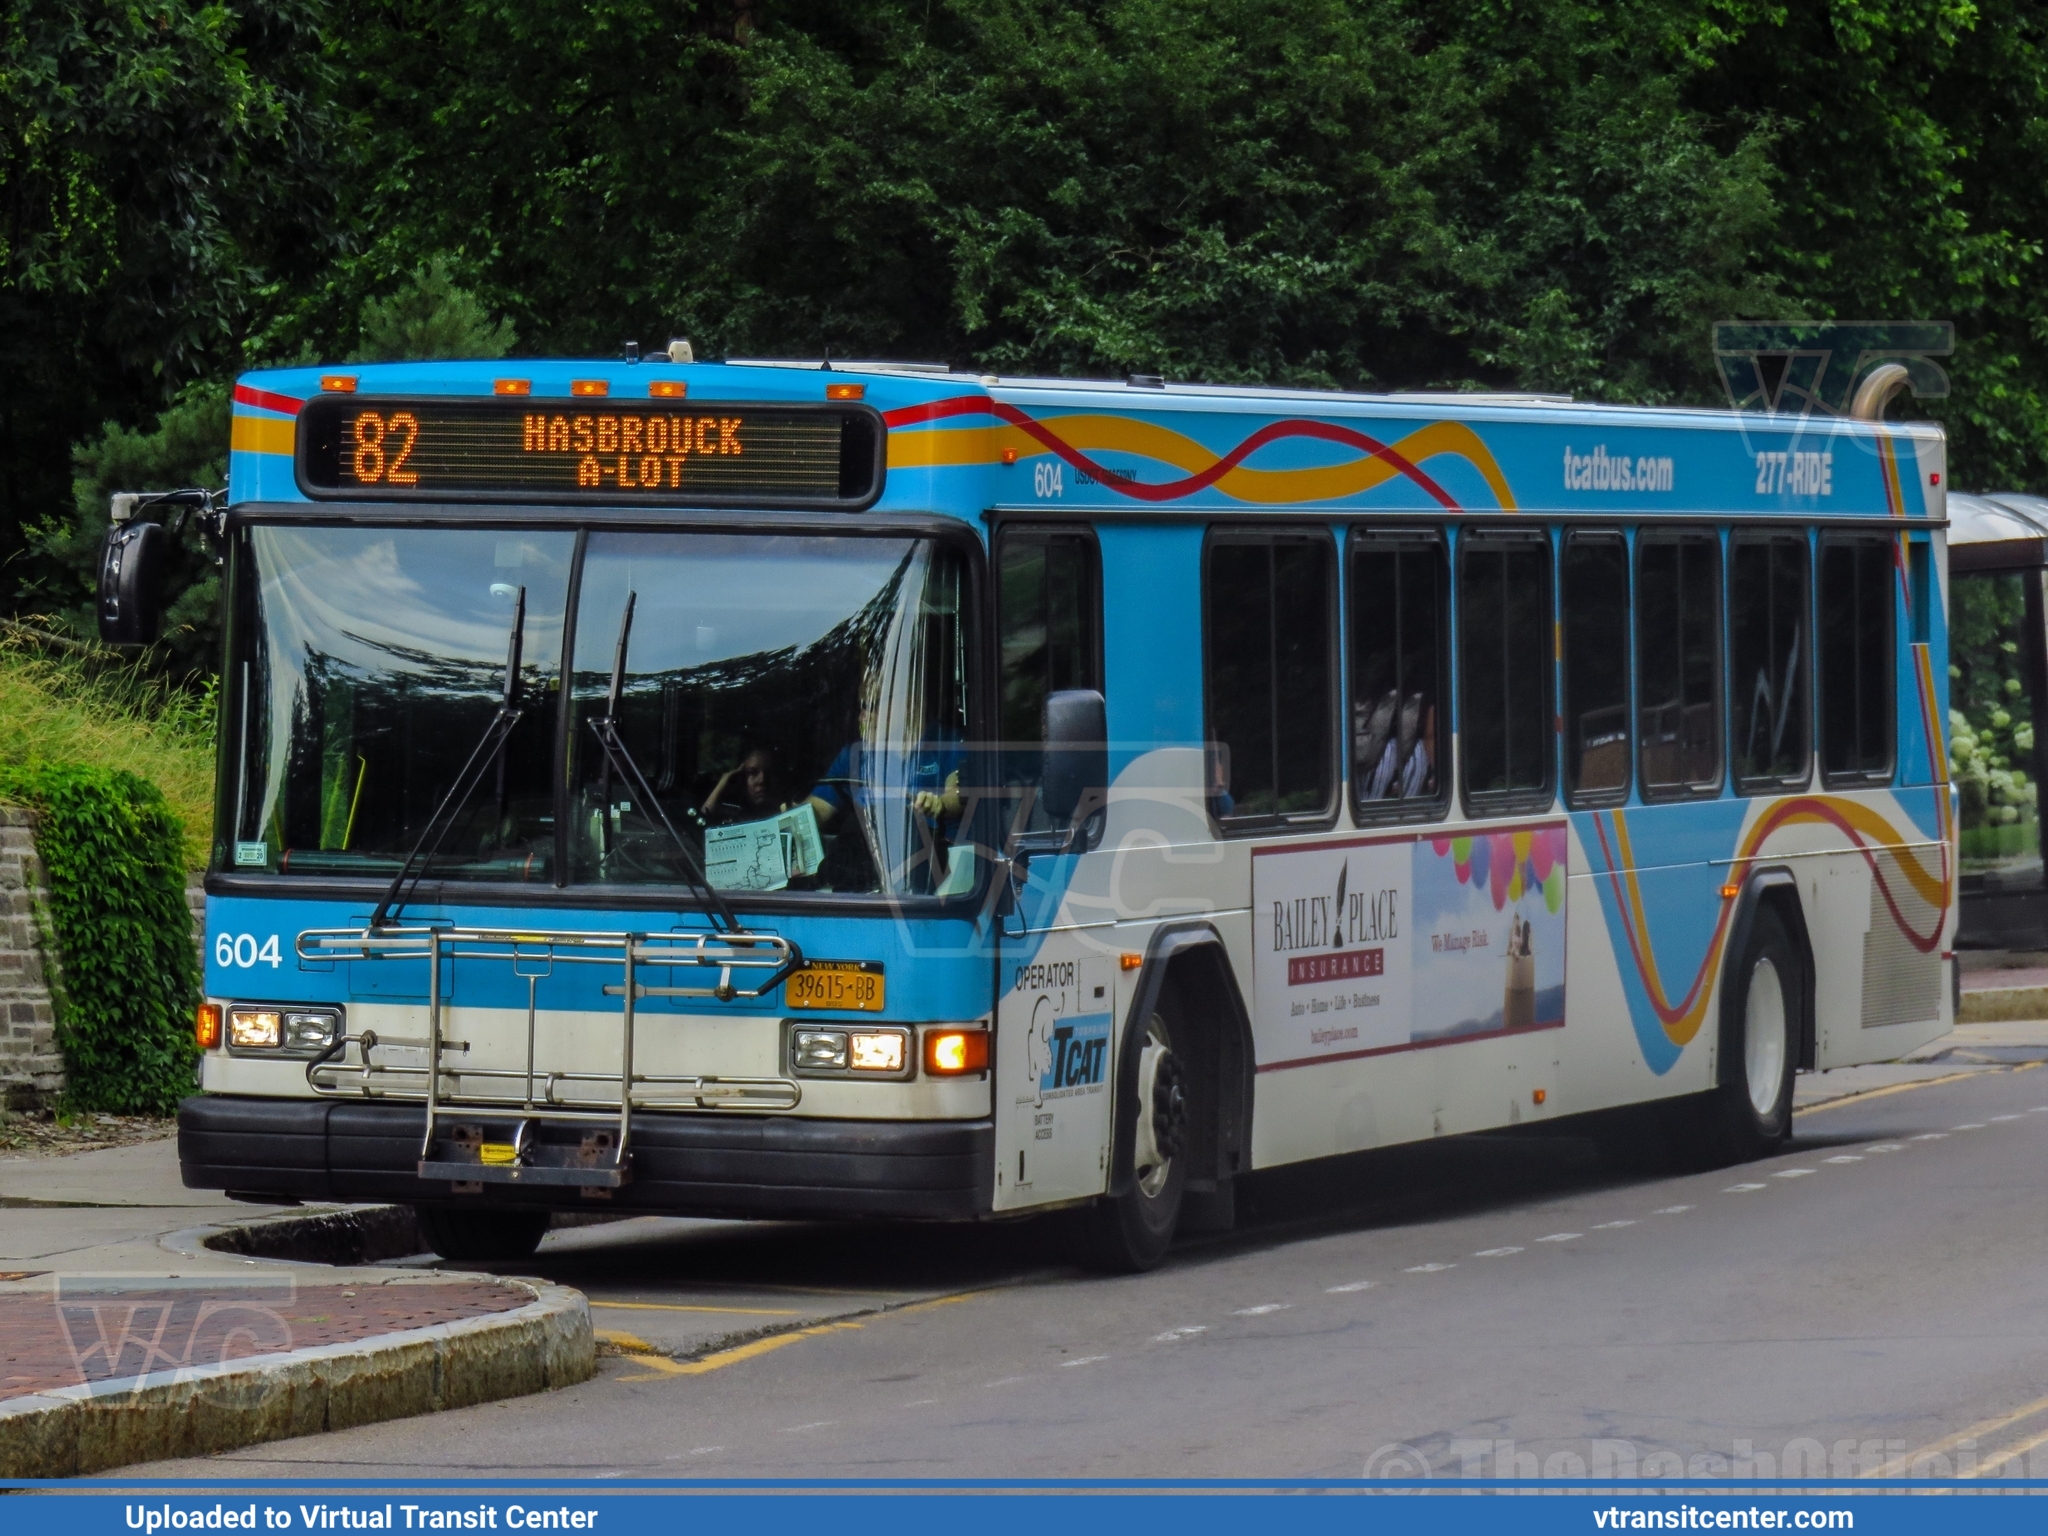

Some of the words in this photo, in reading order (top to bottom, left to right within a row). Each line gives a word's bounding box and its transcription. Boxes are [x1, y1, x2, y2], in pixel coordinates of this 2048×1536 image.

[353, 411, 420, 485] 82
[523, 414, 743, 455] HASBROUCK
[577, 455, 687, 489] A-LOT
[1034, 462, 1063, 498] 604
[1563, 444, 1674, 492] tcatbus.com
[1755, 451, 1833, 496] 277-RIDE
[1273, 896, 1331, 952] BAILEY
[1348, 889, 1398, 943] PLACE
[215, 932, 283, 969] 604
[1431, 934, 1443, 952] We
[1443, 933, 1471, 954] Manage
[811, 962, 835, 971] NEW
[836, 963, 861, 972] YORK
[1015, 961, 1075, 991] OPERATOR
[1290, 954, 1381, 980] INSURANCE
[1290, 1001, 1305, 1017] Auto
[1311, 998, 1329, 1013] Home
[1334, 995, 1347, 1010] Life
[1352, 993, 1380, 1008] Business
[1034, 1113, 1054, 1126] BATTERY
[1035, 1128, 1053, 1140] ACCESS
